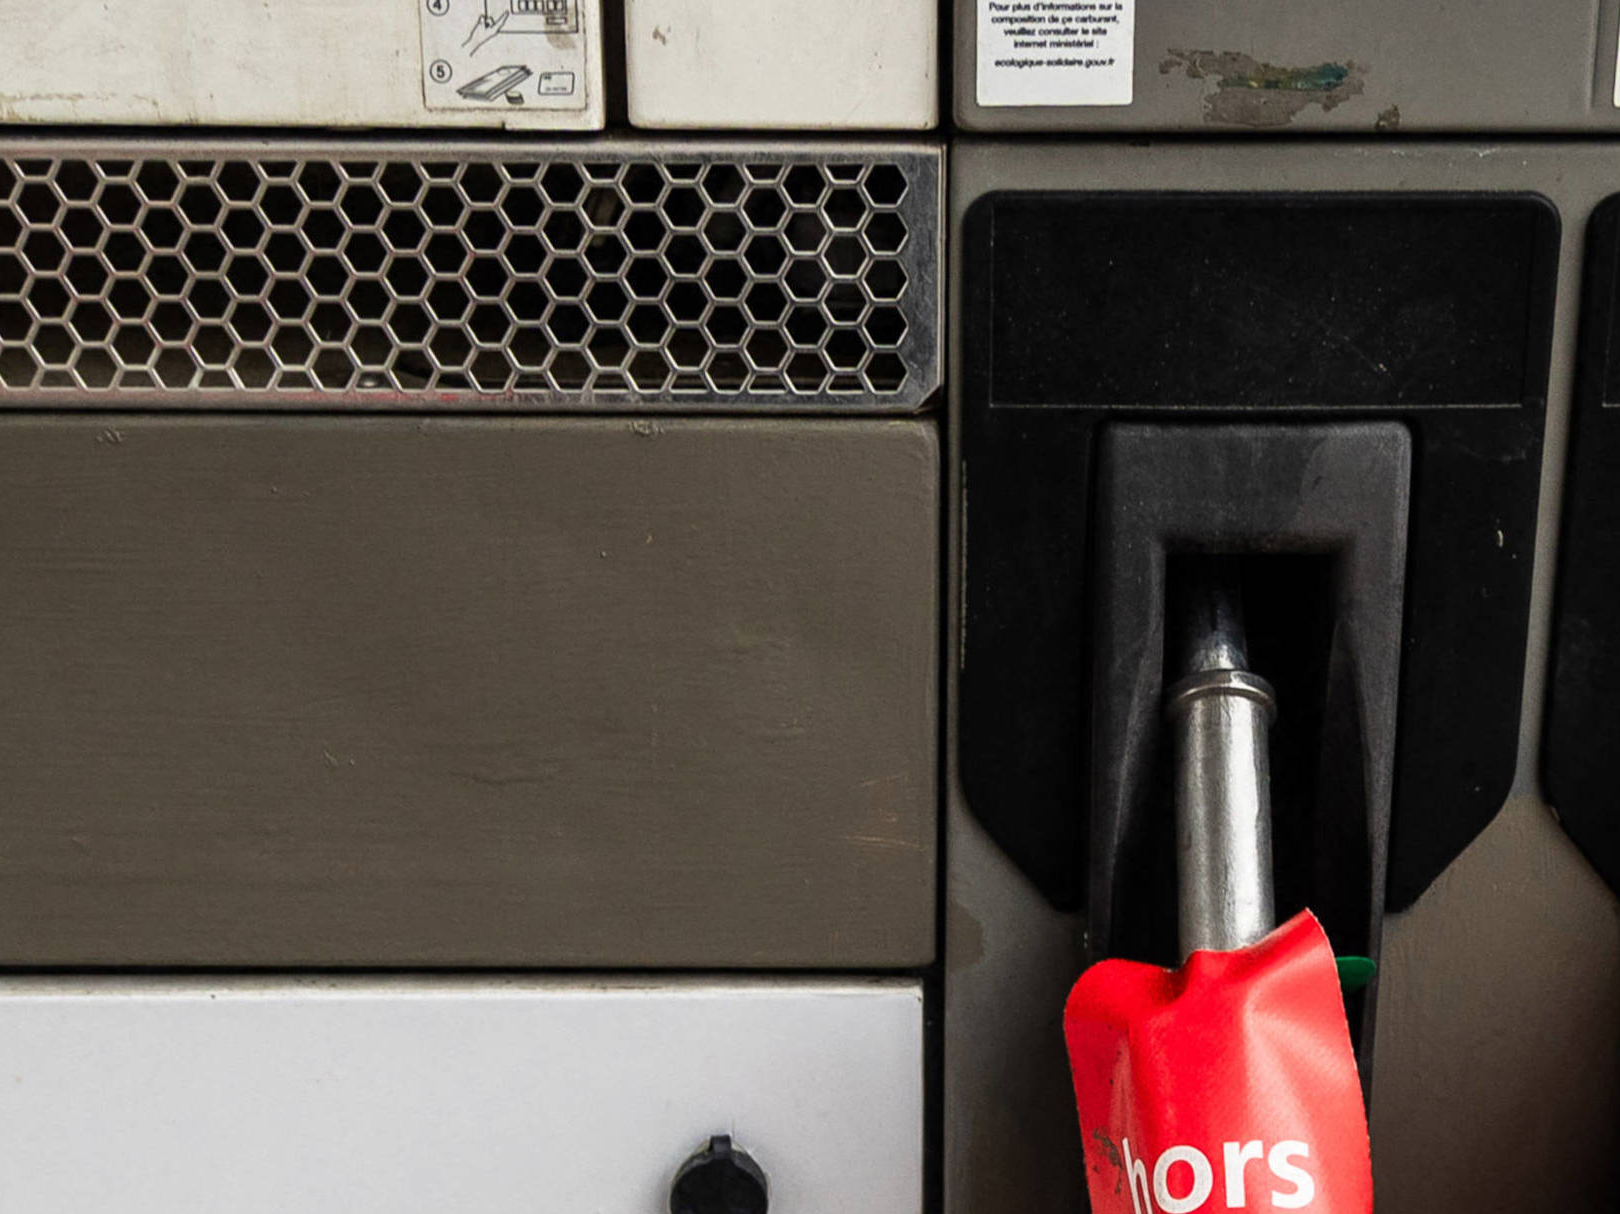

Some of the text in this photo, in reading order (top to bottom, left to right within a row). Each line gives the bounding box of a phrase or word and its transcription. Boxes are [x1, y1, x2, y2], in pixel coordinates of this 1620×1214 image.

[989, 3, 1009, 11] Pour
[1012, 3, 1031, 12] plus
[1115, 3, 1123, 11] la
[991, 15, 1045, 25] composition
[1048, 15, 1059, 23] de
[1004, 27, 1107, 36] veuillez consulter le site
[1049, 39, 1094, 48] ministériel
[436, 65, 445, 79] 5
